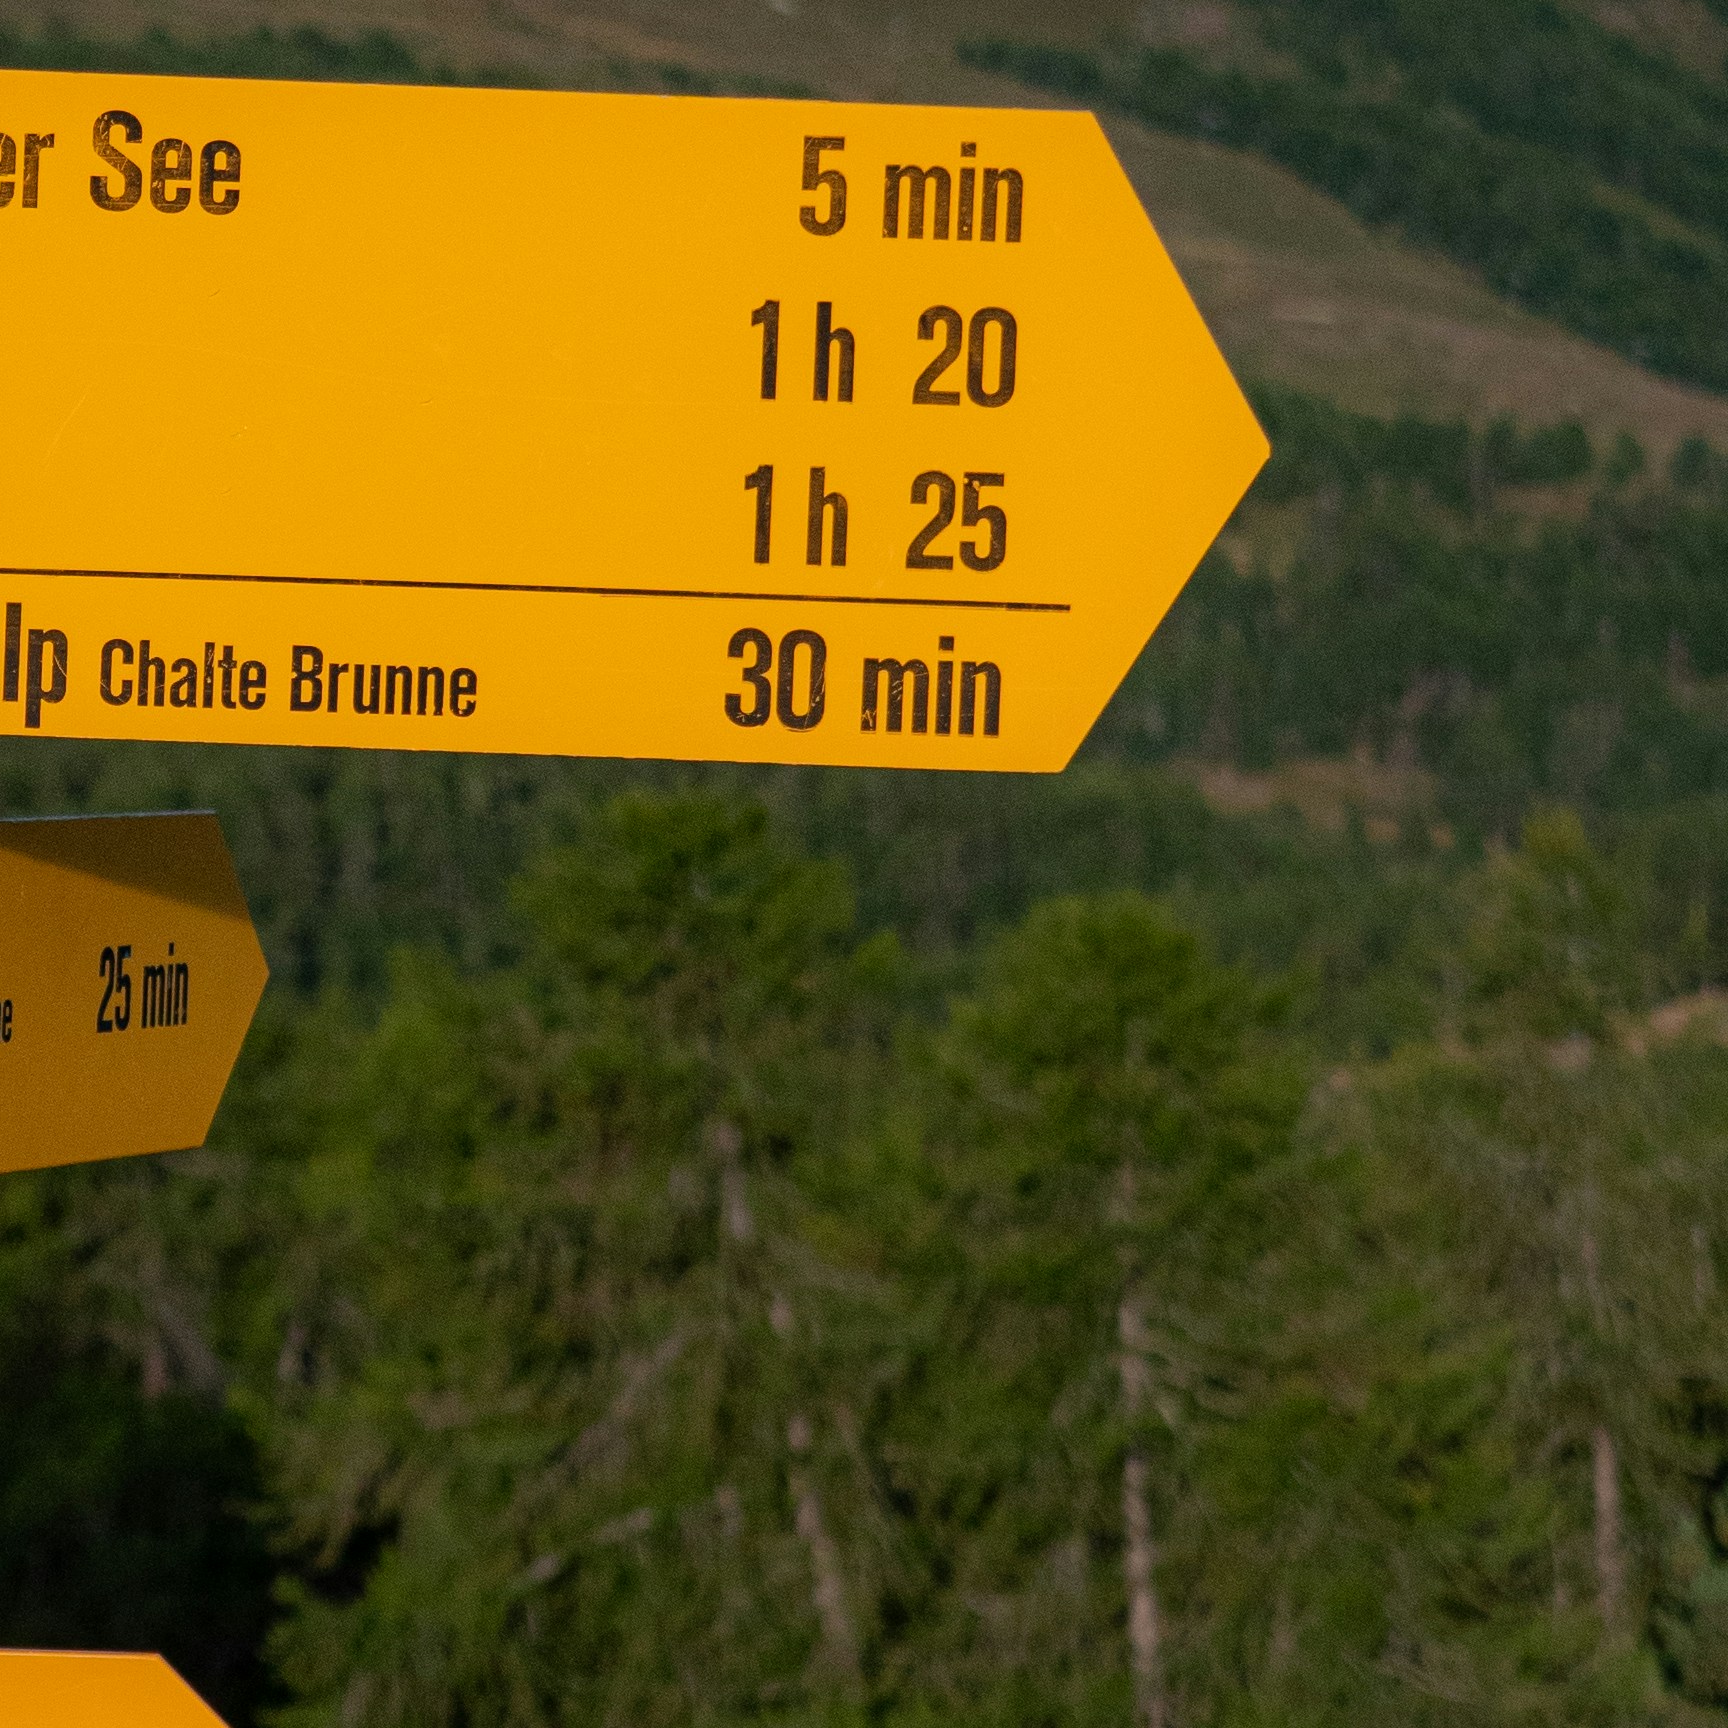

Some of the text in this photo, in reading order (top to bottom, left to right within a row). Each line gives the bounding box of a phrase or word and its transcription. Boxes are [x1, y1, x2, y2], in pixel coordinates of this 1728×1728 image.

[89, 109, 242, 216] See
[799, 135, 1024, 243] 5 min
[751, 299, 1018, 409] 1 h 20
[744, 464, 1009, 572] 1 h 25
[99, 638, 268, 711] Chalte
[289, 645, 478, 718] Brunne
[724, 627, 1002, 737] 30 min
[96, 942, 190, 1034] 25 min
